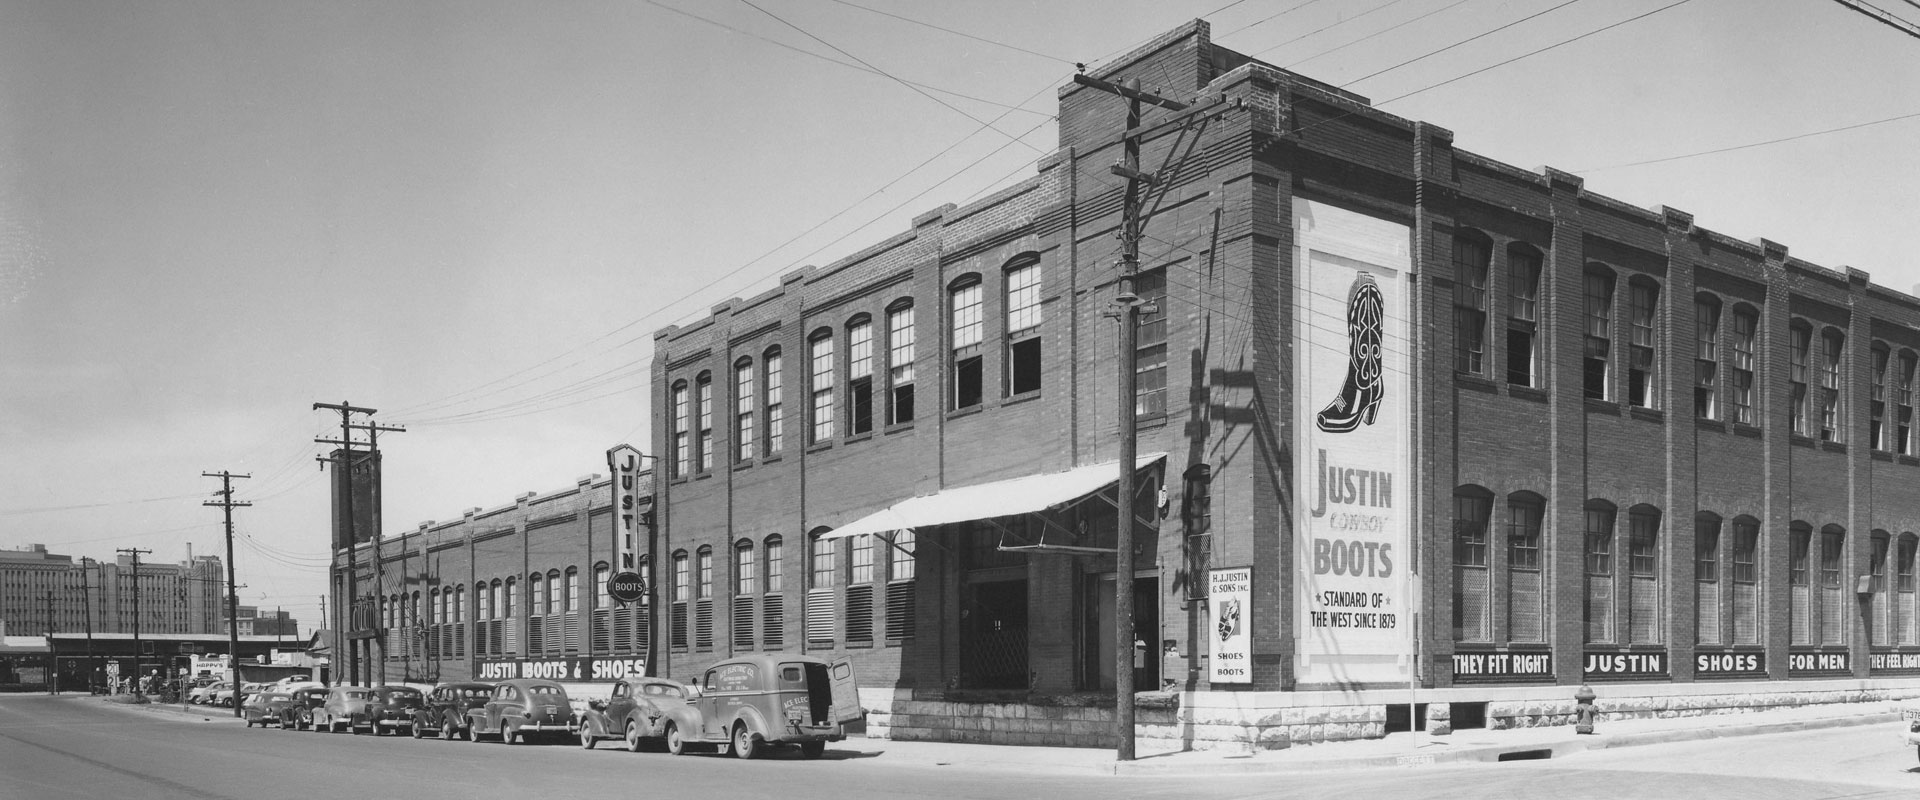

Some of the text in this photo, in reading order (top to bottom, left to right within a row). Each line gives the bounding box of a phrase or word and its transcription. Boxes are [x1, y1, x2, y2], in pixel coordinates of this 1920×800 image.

[1311, 448, 1392, 518] JUSTIN
[621, 455, 634, 569] JUSTIN
[1314, 538, 1393, 578] BOOTS
[615, 582, 643, 592] BOOTS
[1219, 584, 1236, 592] SONS
[1324, 591, 1383, 608] STANDARD OF
[1311, 611, 1396, 629] THE WEST SINCE 1879
[522, 661, 567, 678] BOOTS
[592, 660, 645, 678] SHOES
[1452, 655, 1548, 674] THEY FIT RIGHT
[1584, 655, 1660, 673] JUSTIN
[1698, 655, 1757, 671] SHOES
[1789, 655, 1845, 670] FOR MEN
[1887, 654, 1901, 668] FEEL
